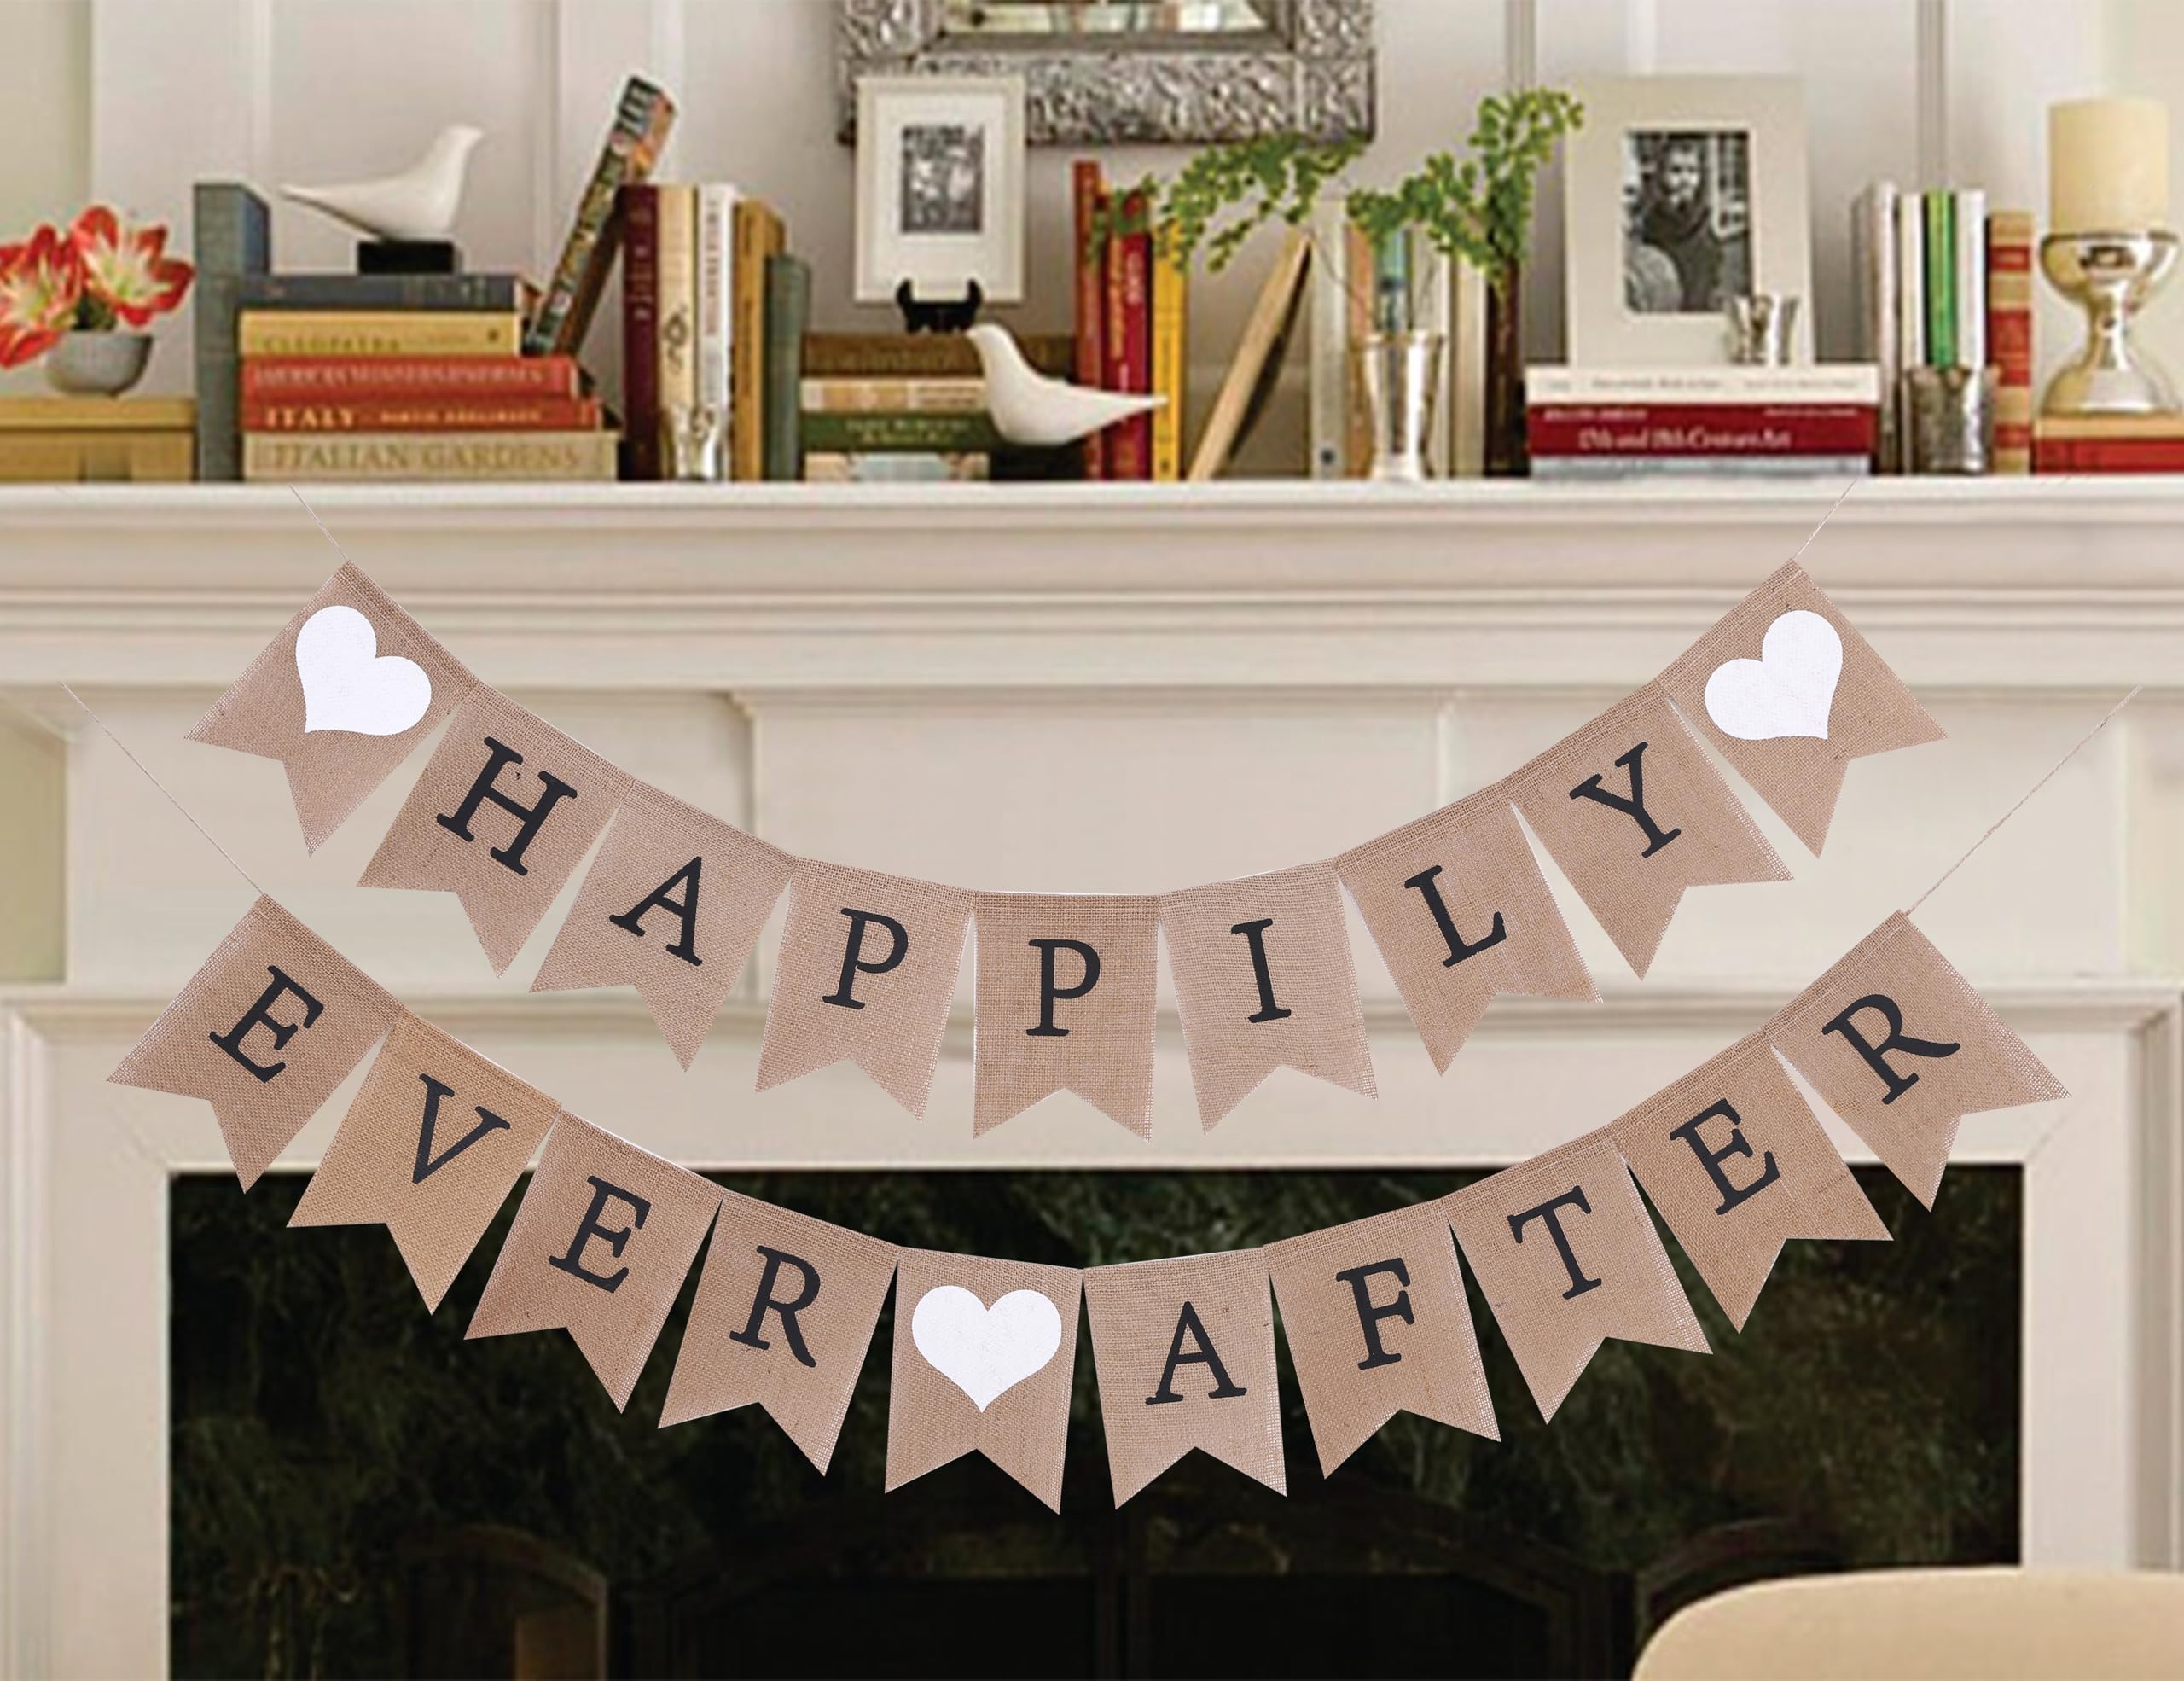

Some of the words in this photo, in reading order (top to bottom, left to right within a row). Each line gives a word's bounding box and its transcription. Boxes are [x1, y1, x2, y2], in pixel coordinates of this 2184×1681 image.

[267, 407, 357, 426] ITALY
[273, 444, 408, 469] ITALIAN
[422, 444, 581, 469] GARDENS
[437, 737, 1682, 1037] HAPPILY
[209, 966, 820, 1367] EVER
[1146, 994, 1960, 1405] AFTER
